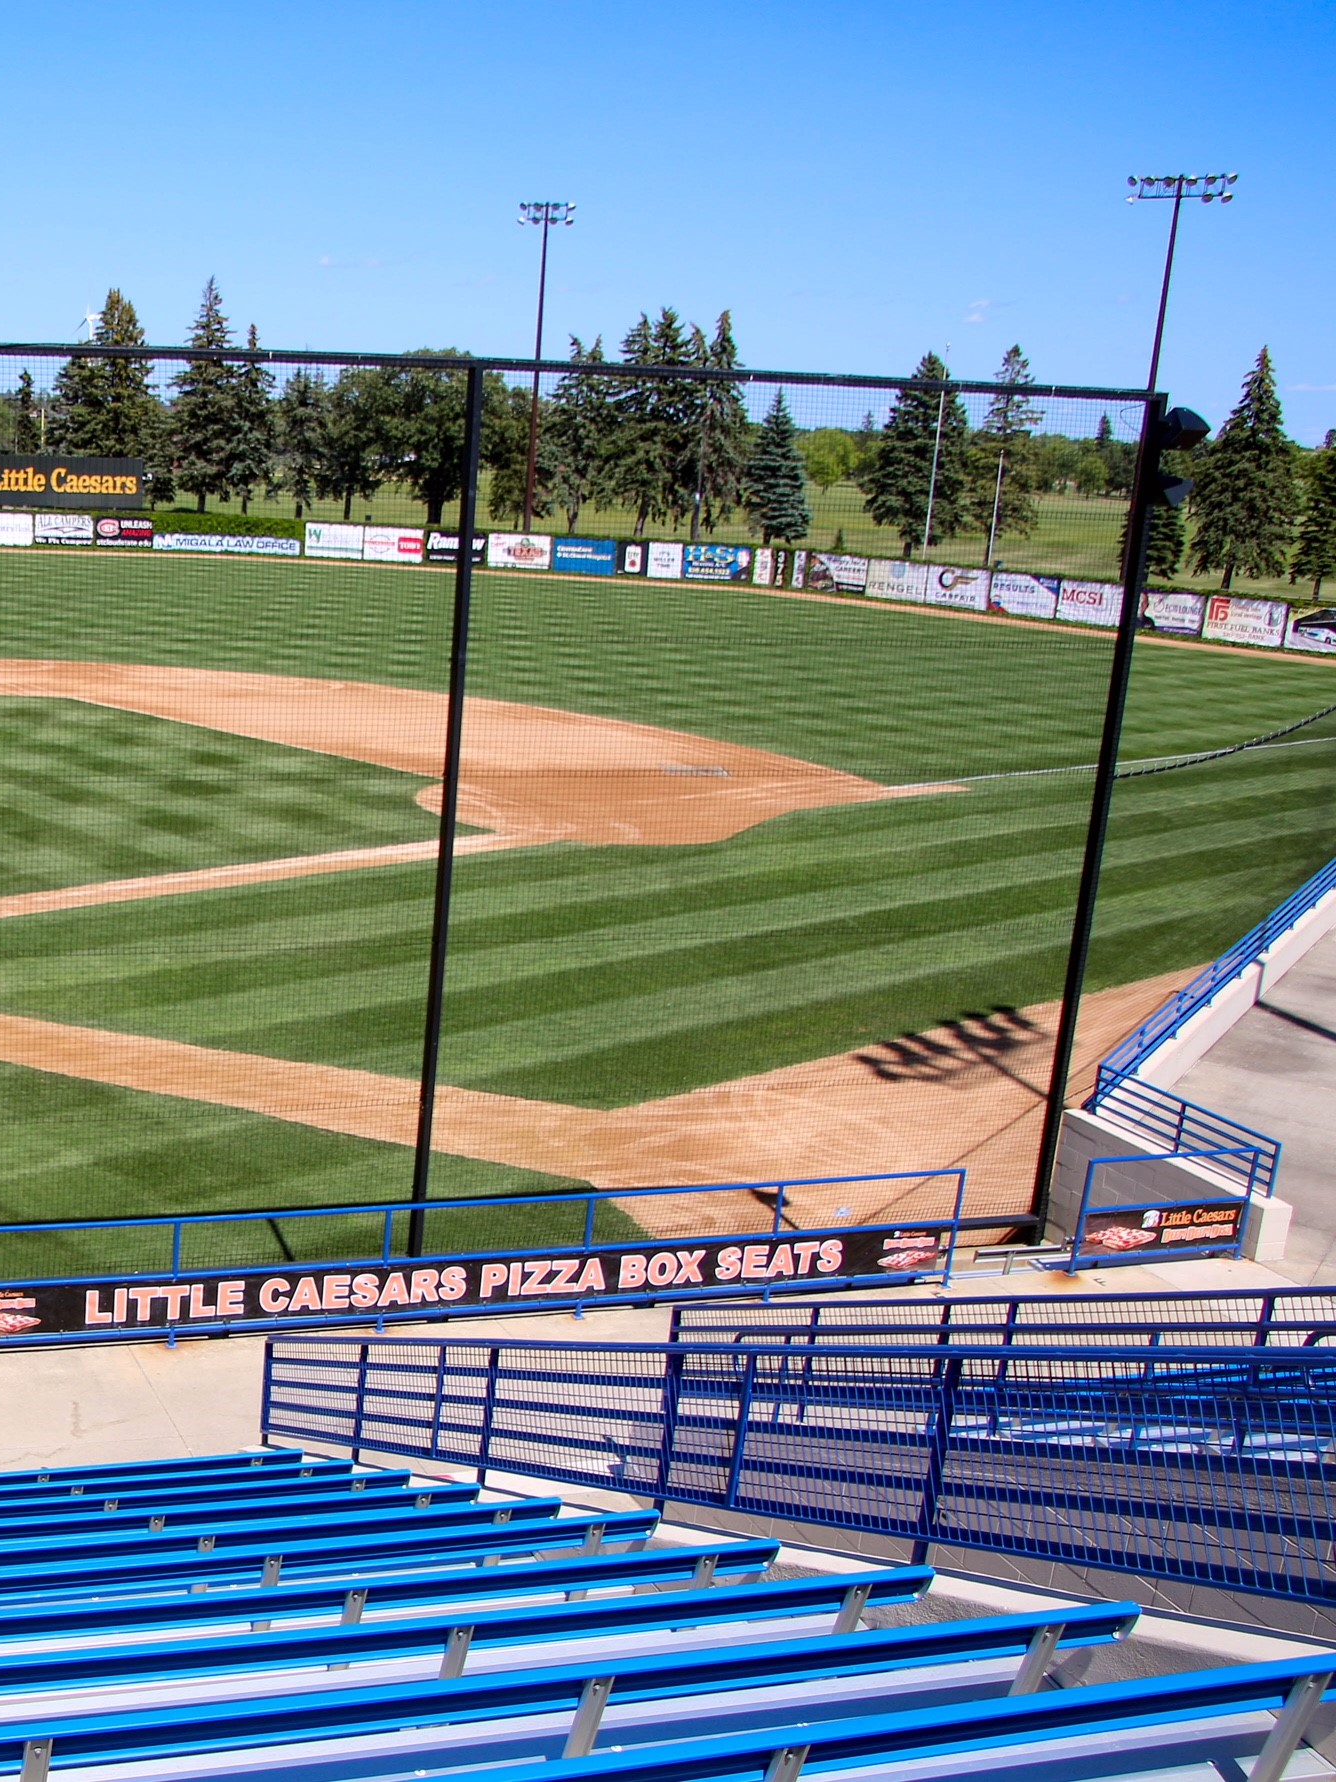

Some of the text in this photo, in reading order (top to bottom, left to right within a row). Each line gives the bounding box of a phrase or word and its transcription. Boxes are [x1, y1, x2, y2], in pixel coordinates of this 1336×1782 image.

[50, 467, 139, 495] Caesars
[120, 520, 153, 530] UNLEASH
[175, 537, 297, 552] MIGALA LAW OFFICE
[774, 550, 786, 586] 375
[868, 581, 922, 596] RENGEL
[993, 582, 1036, 594] RESULTS
[1061, 588, 1103, 606] MCSI
[1207, 621, 1280, 637] FIRST FUEL BANKS
[1160, 1207, 1236, 1226] Little Caesars
[84, 1238, 845, 1325] LITTLE CAESARS PIZZA BOX SEATS
